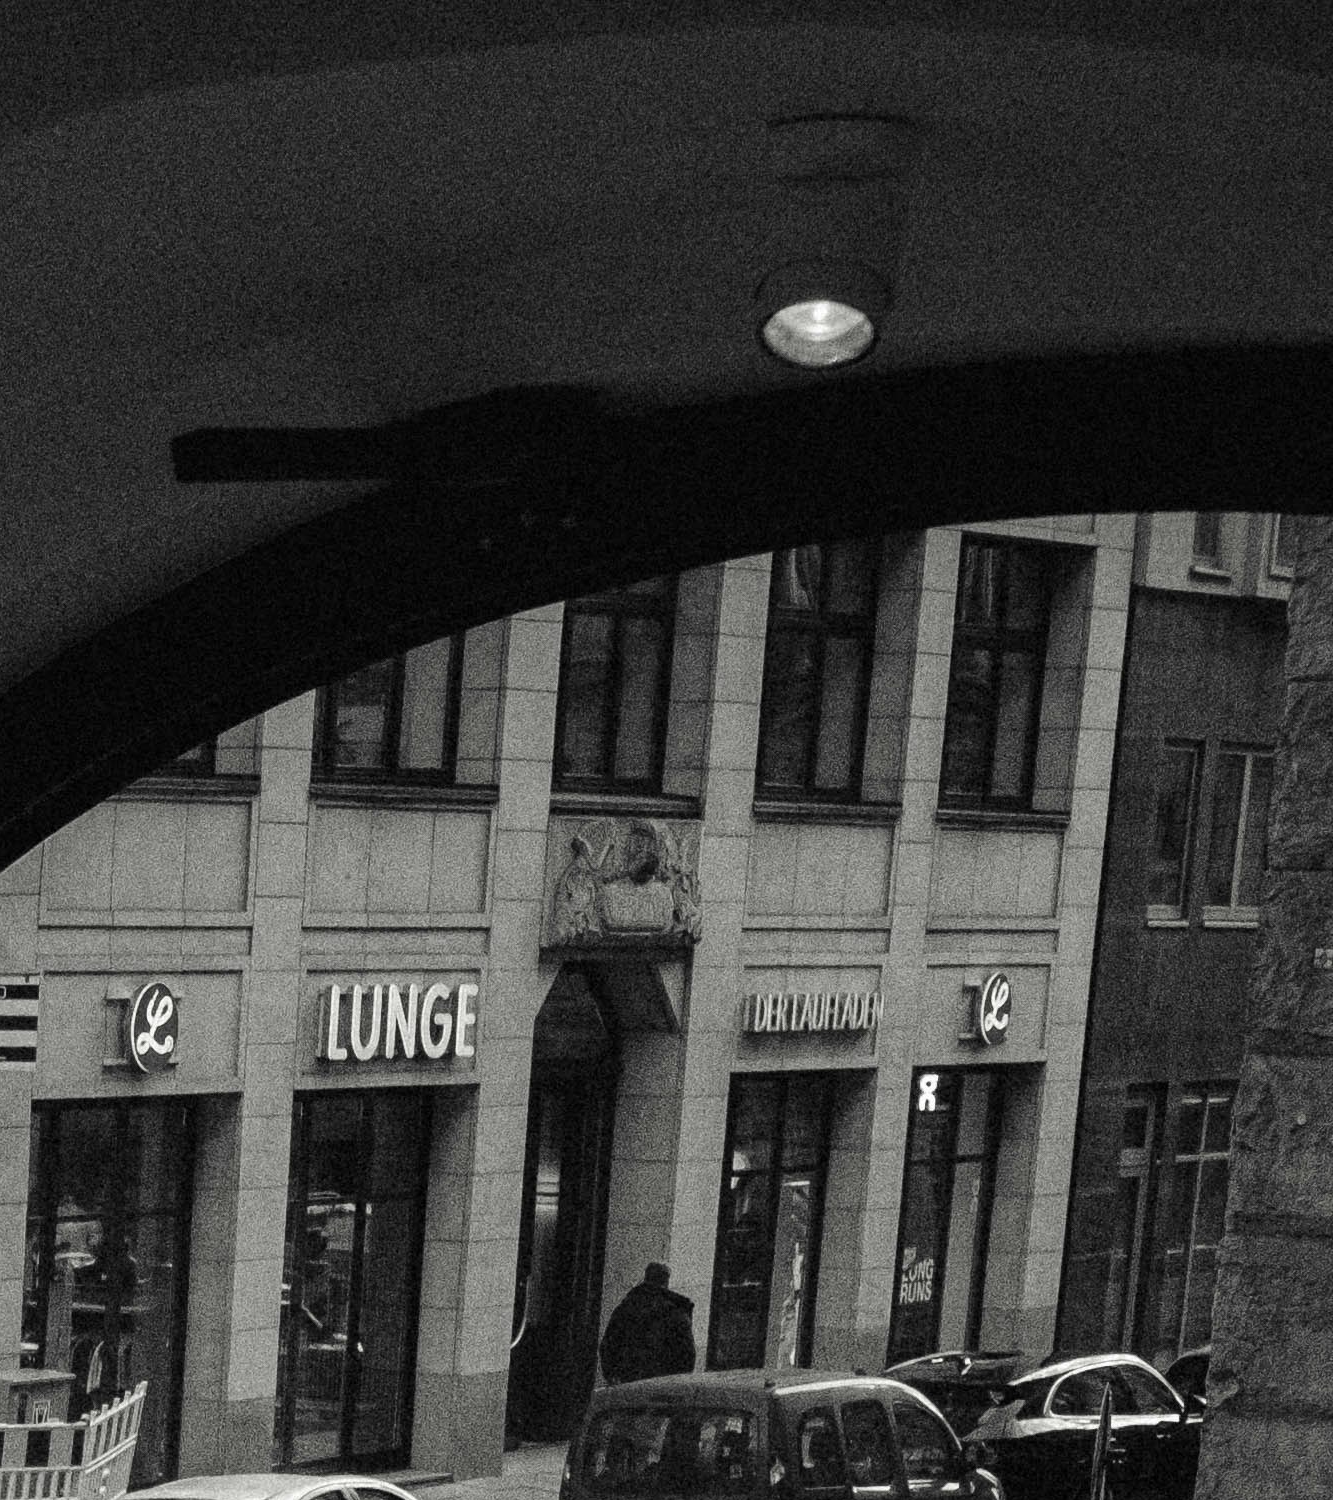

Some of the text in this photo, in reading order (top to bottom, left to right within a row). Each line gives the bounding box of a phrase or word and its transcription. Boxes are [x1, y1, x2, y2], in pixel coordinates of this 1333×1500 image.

[327, 982, 479, 1062] LUNGE
[753, 991, 885, 1033] DER LAUFLADEN
[898, 1281, 933, 1305] RUNS
